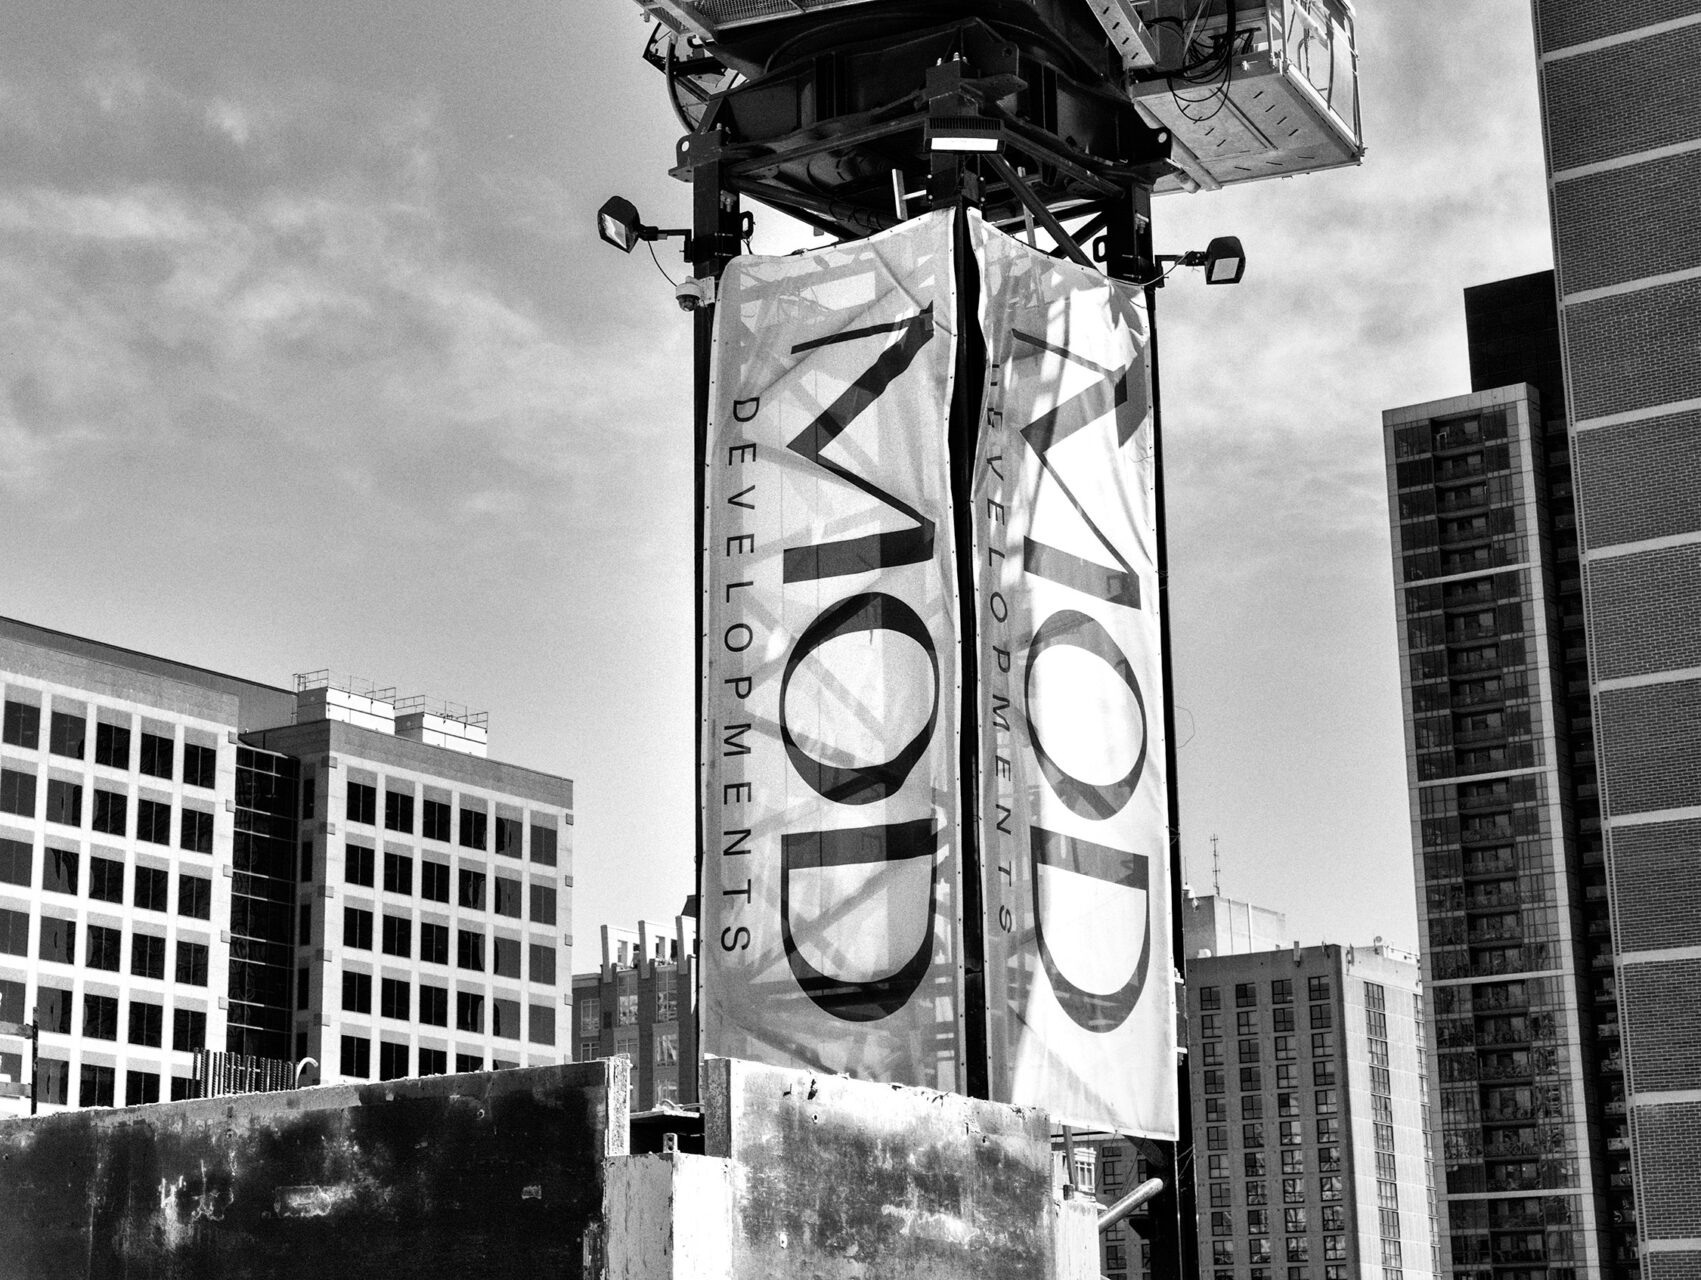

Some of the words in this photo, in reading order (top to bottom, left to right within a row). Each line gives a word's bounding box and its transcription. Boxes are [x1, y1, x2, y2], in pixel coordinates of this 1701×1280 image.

[721, 397, 760, 952] DEVELOPMENTS
[779, 300, 940, 1022] MOD
[1011, 328, 1151, 1034] MOD
